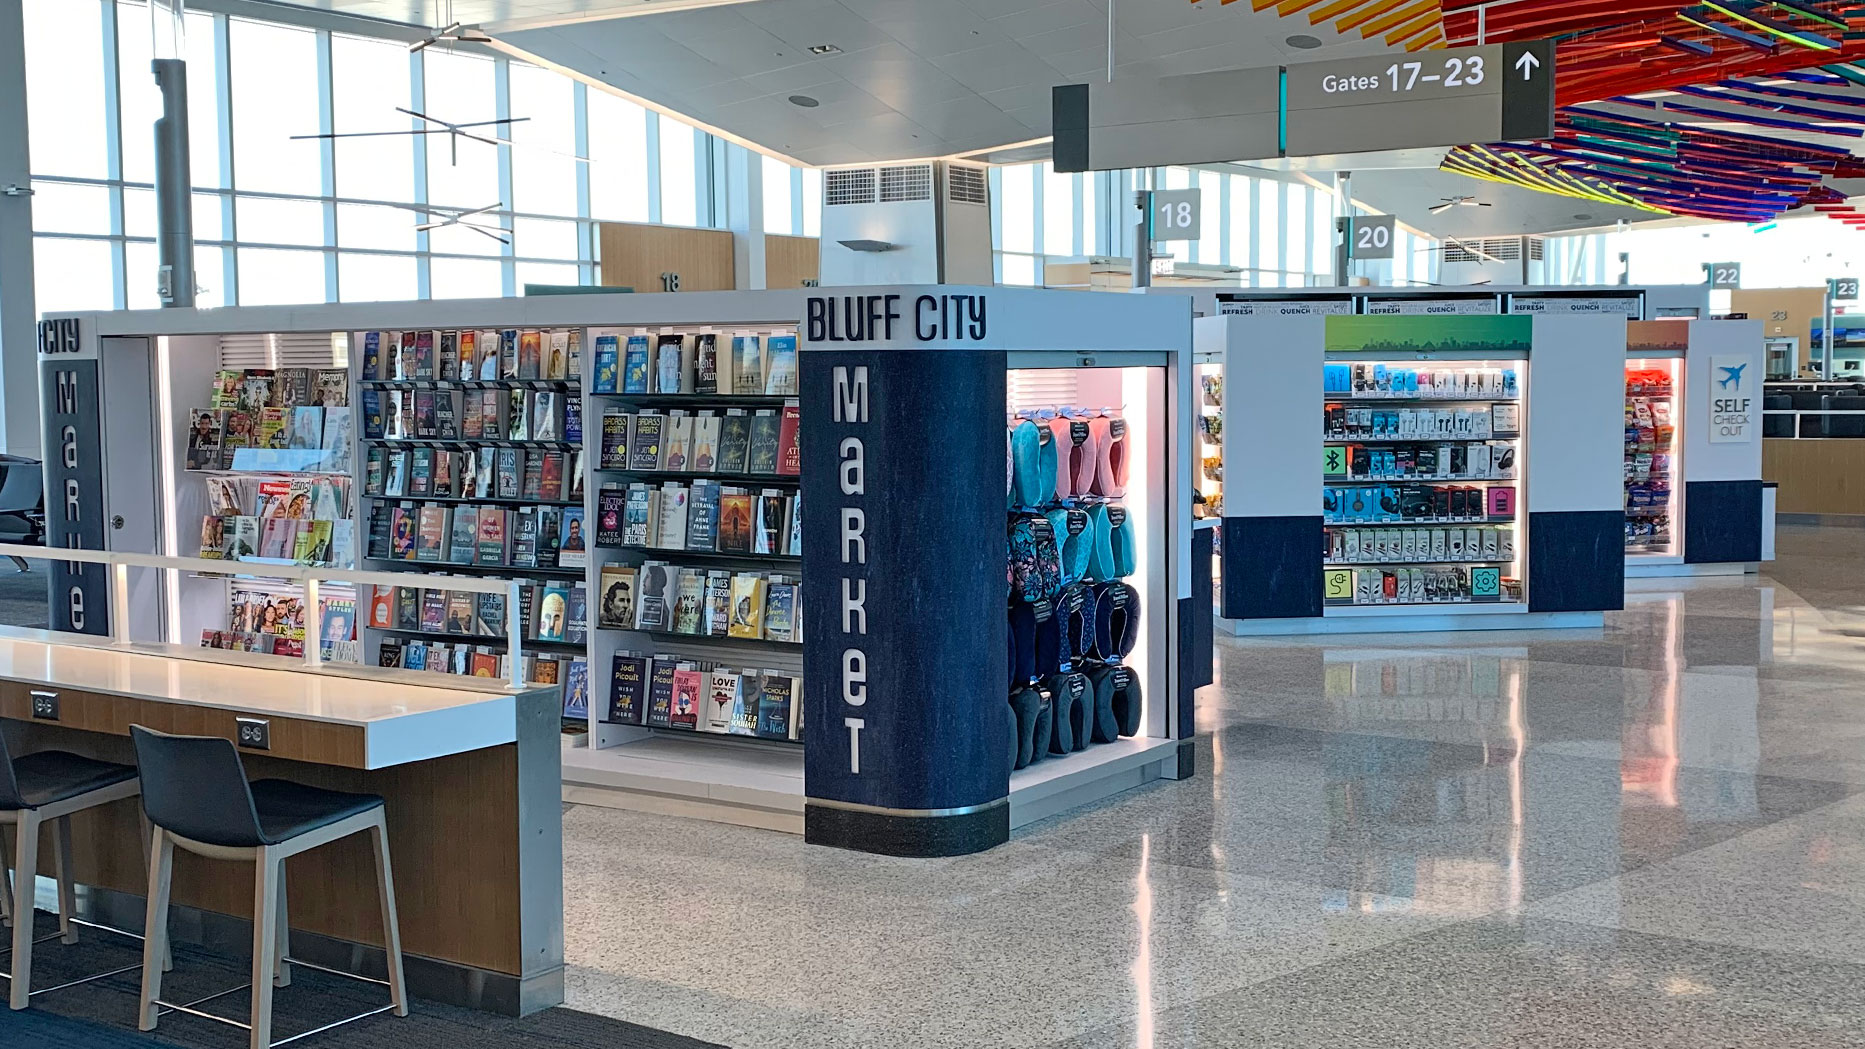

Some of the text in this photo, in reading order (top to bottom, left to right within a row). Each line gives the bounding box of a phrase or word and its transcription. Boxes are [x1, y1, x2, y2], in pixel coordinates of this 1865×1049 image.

[1322, 75, 1379, 93] Gates
[1161, 202, 1192, 228] 18
[1357, 226, 1390, 248] 20
[1716, 268, 1738, 284] 22
[660, 272, 680, 292] 18
[1837, 282, 1857, 295] 23
[807, 294, 987, 341] BLUFF CITY
[1770, 310, 1788, 322] 23
[41, 318, 80, 354] CITY
[1714, 399, 1751, 412] SELF
[603, 417, 627, 426] BADASS
[638, 417, 661, 426] BADASS
[1713, 414, 1751, 424] CHECK
[604, 426, 625, 434] HABITS
[638, 426, 659, 434] HABITS
[1720, 426, 1744, 436] OUT
[720, 435, 747, 450] Verity
[751, 436, 778, 450] Verity
[602, 453, 626, 462] SINCERO
[633, 454, 657, 463] SINCERO
[631, 491, 646, 501] JAMES
[600, 497, 625, 506] ELECTRIC
[691, 502, 715, 510] BETRAYAL
[604, 503, 619, 511] IDOL
[631, 523, 647, 536] PARIS
[623, 535, 646, 546] DETECTIVE
[620, 663, 635, 672] Jodi
[658, 667, 673, 675] Jodi
[615, 672, 640, 681] Picoult
[712, 677, 736, 687] LOVE
[761, 686, 790, 695] NICHOLAS
[732, 713, 758, 721] SISTER
